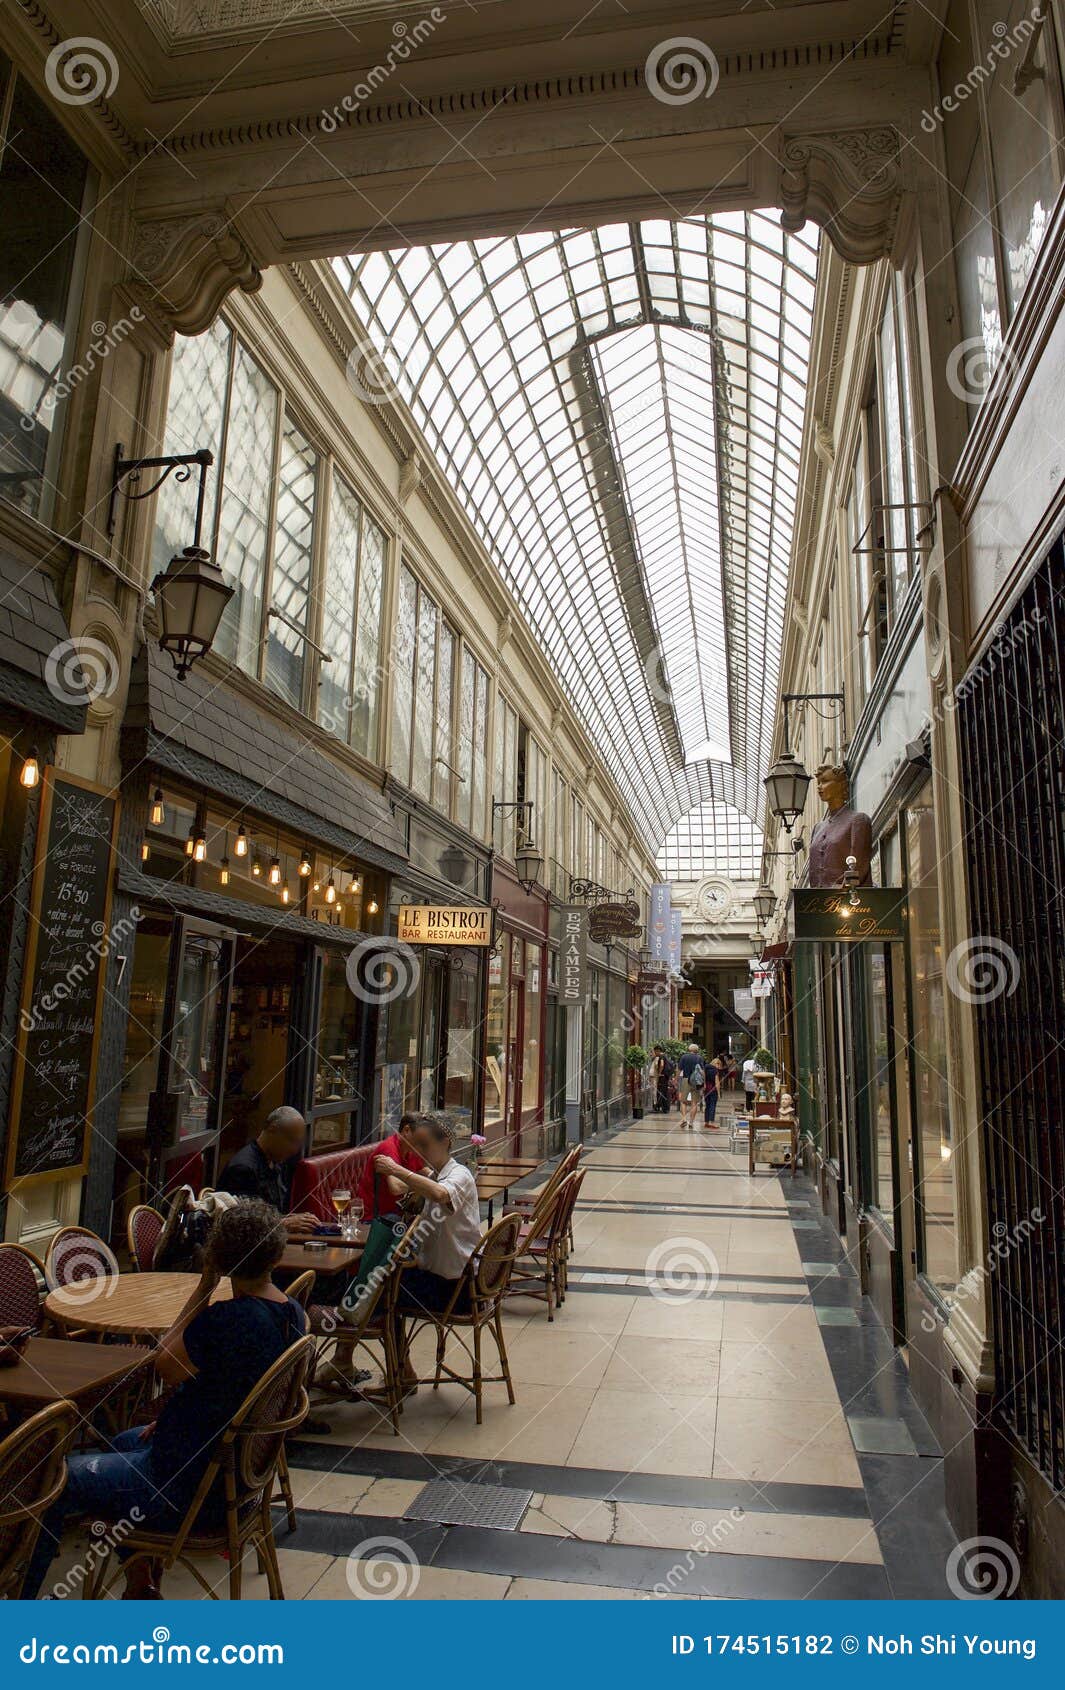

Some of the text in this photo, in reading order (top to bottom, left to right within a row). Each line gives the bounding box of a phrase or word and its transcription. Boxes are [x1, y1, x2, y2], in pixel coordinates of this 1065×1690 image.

[403, 910, 488, 928] LE BISTROT
[402, 929, 487, 940] BAR RESTAURANT
[834, 922, 852, 935] des
[564, 912, 581, 999] ESTAMPES
[116, 955, 128, 986] 7
